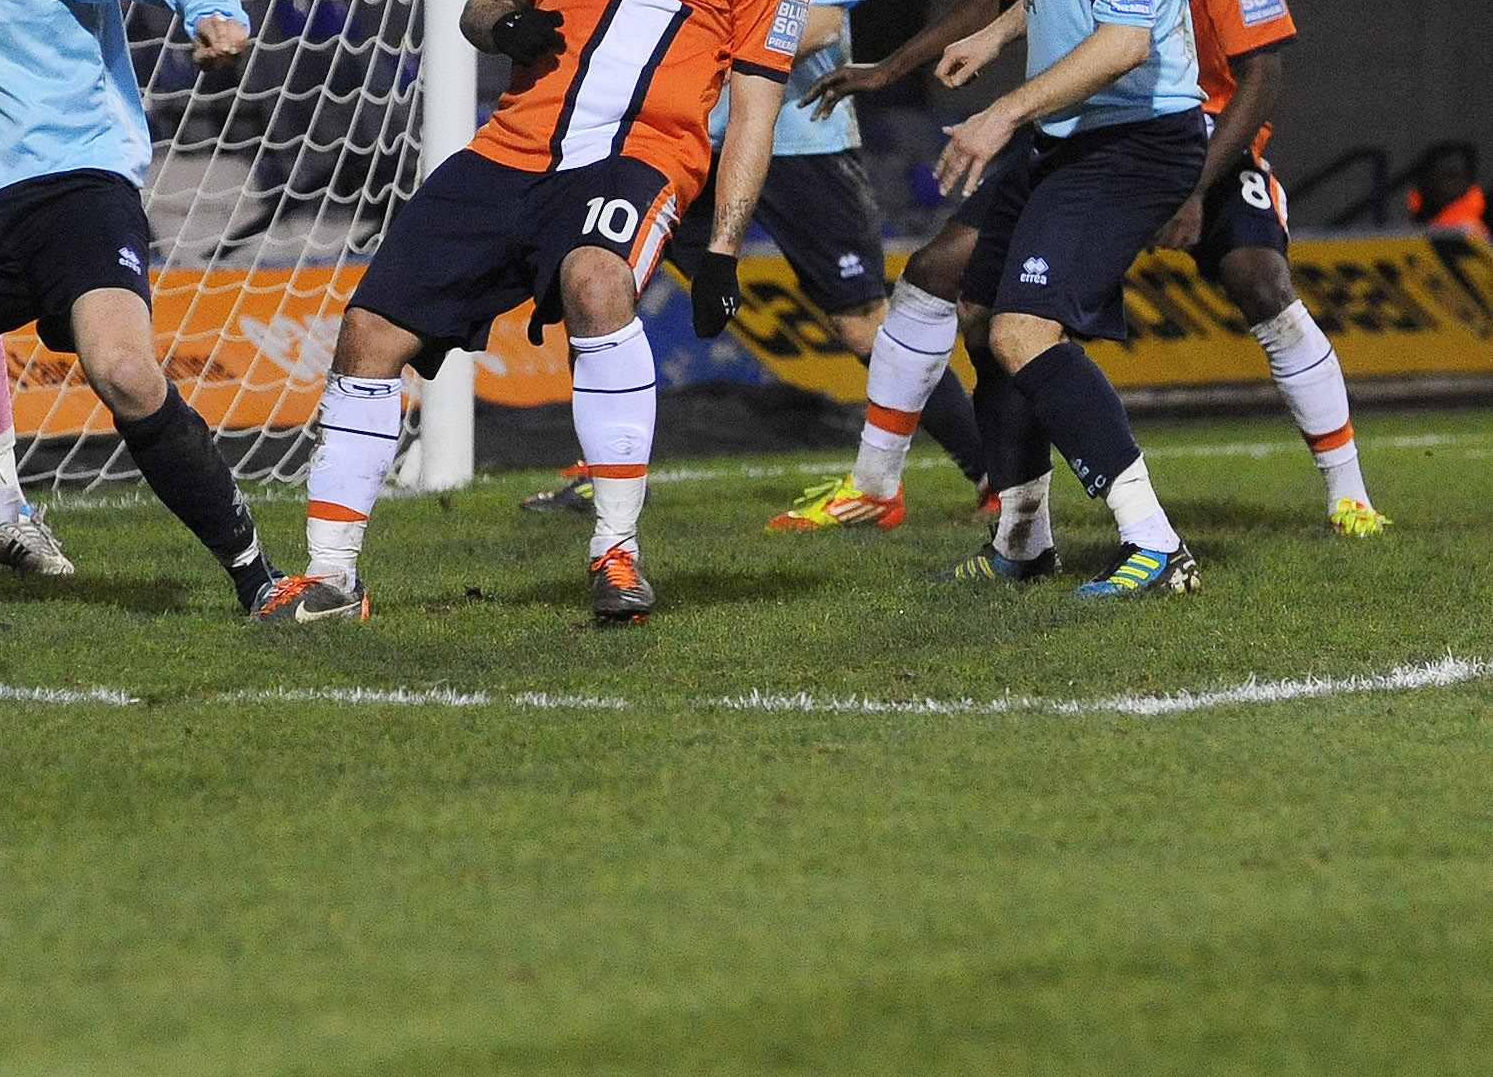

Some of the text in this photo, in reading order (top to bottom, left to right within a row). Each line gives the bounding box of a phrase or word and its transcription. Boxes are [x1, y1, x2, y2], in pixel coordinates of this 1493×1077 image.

[772, 16, 800, 38] SQ
[1239, 170, 1272, 210] 8
[581, 196, 639, 244] 10
